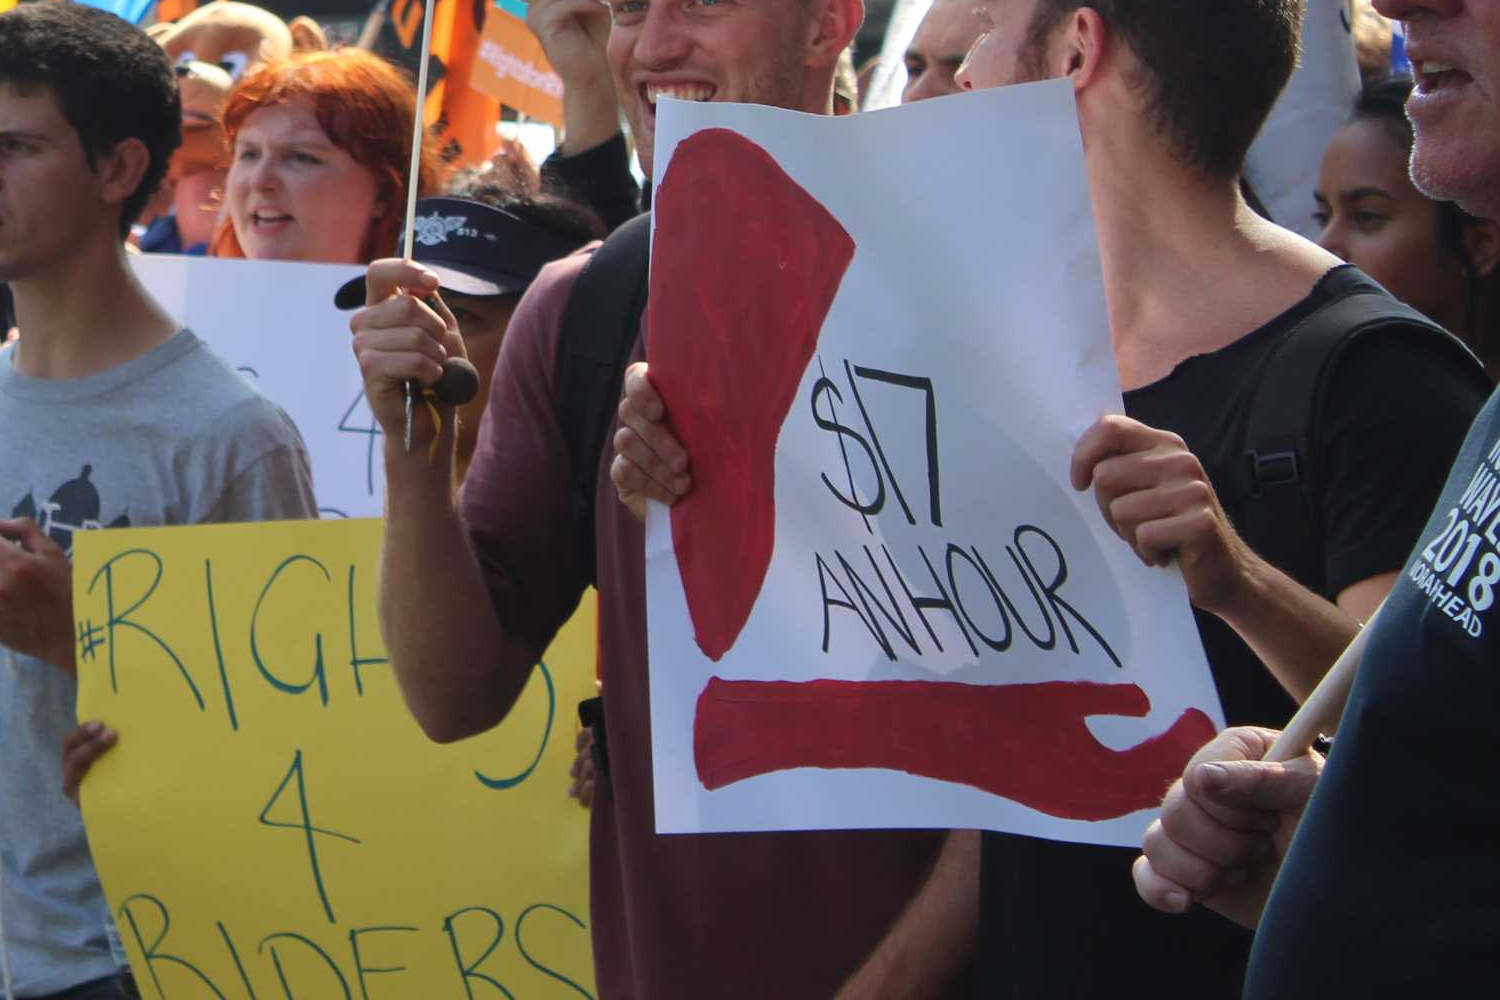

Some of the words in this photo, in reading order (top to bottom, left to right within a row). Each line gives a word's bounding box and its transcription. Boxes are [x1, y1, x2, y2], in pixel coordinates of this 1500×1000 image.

[810, 354, 944, 536] $17
[1421, 507, 1500, 612] 2018
[259, 748, 362, 925] 4
